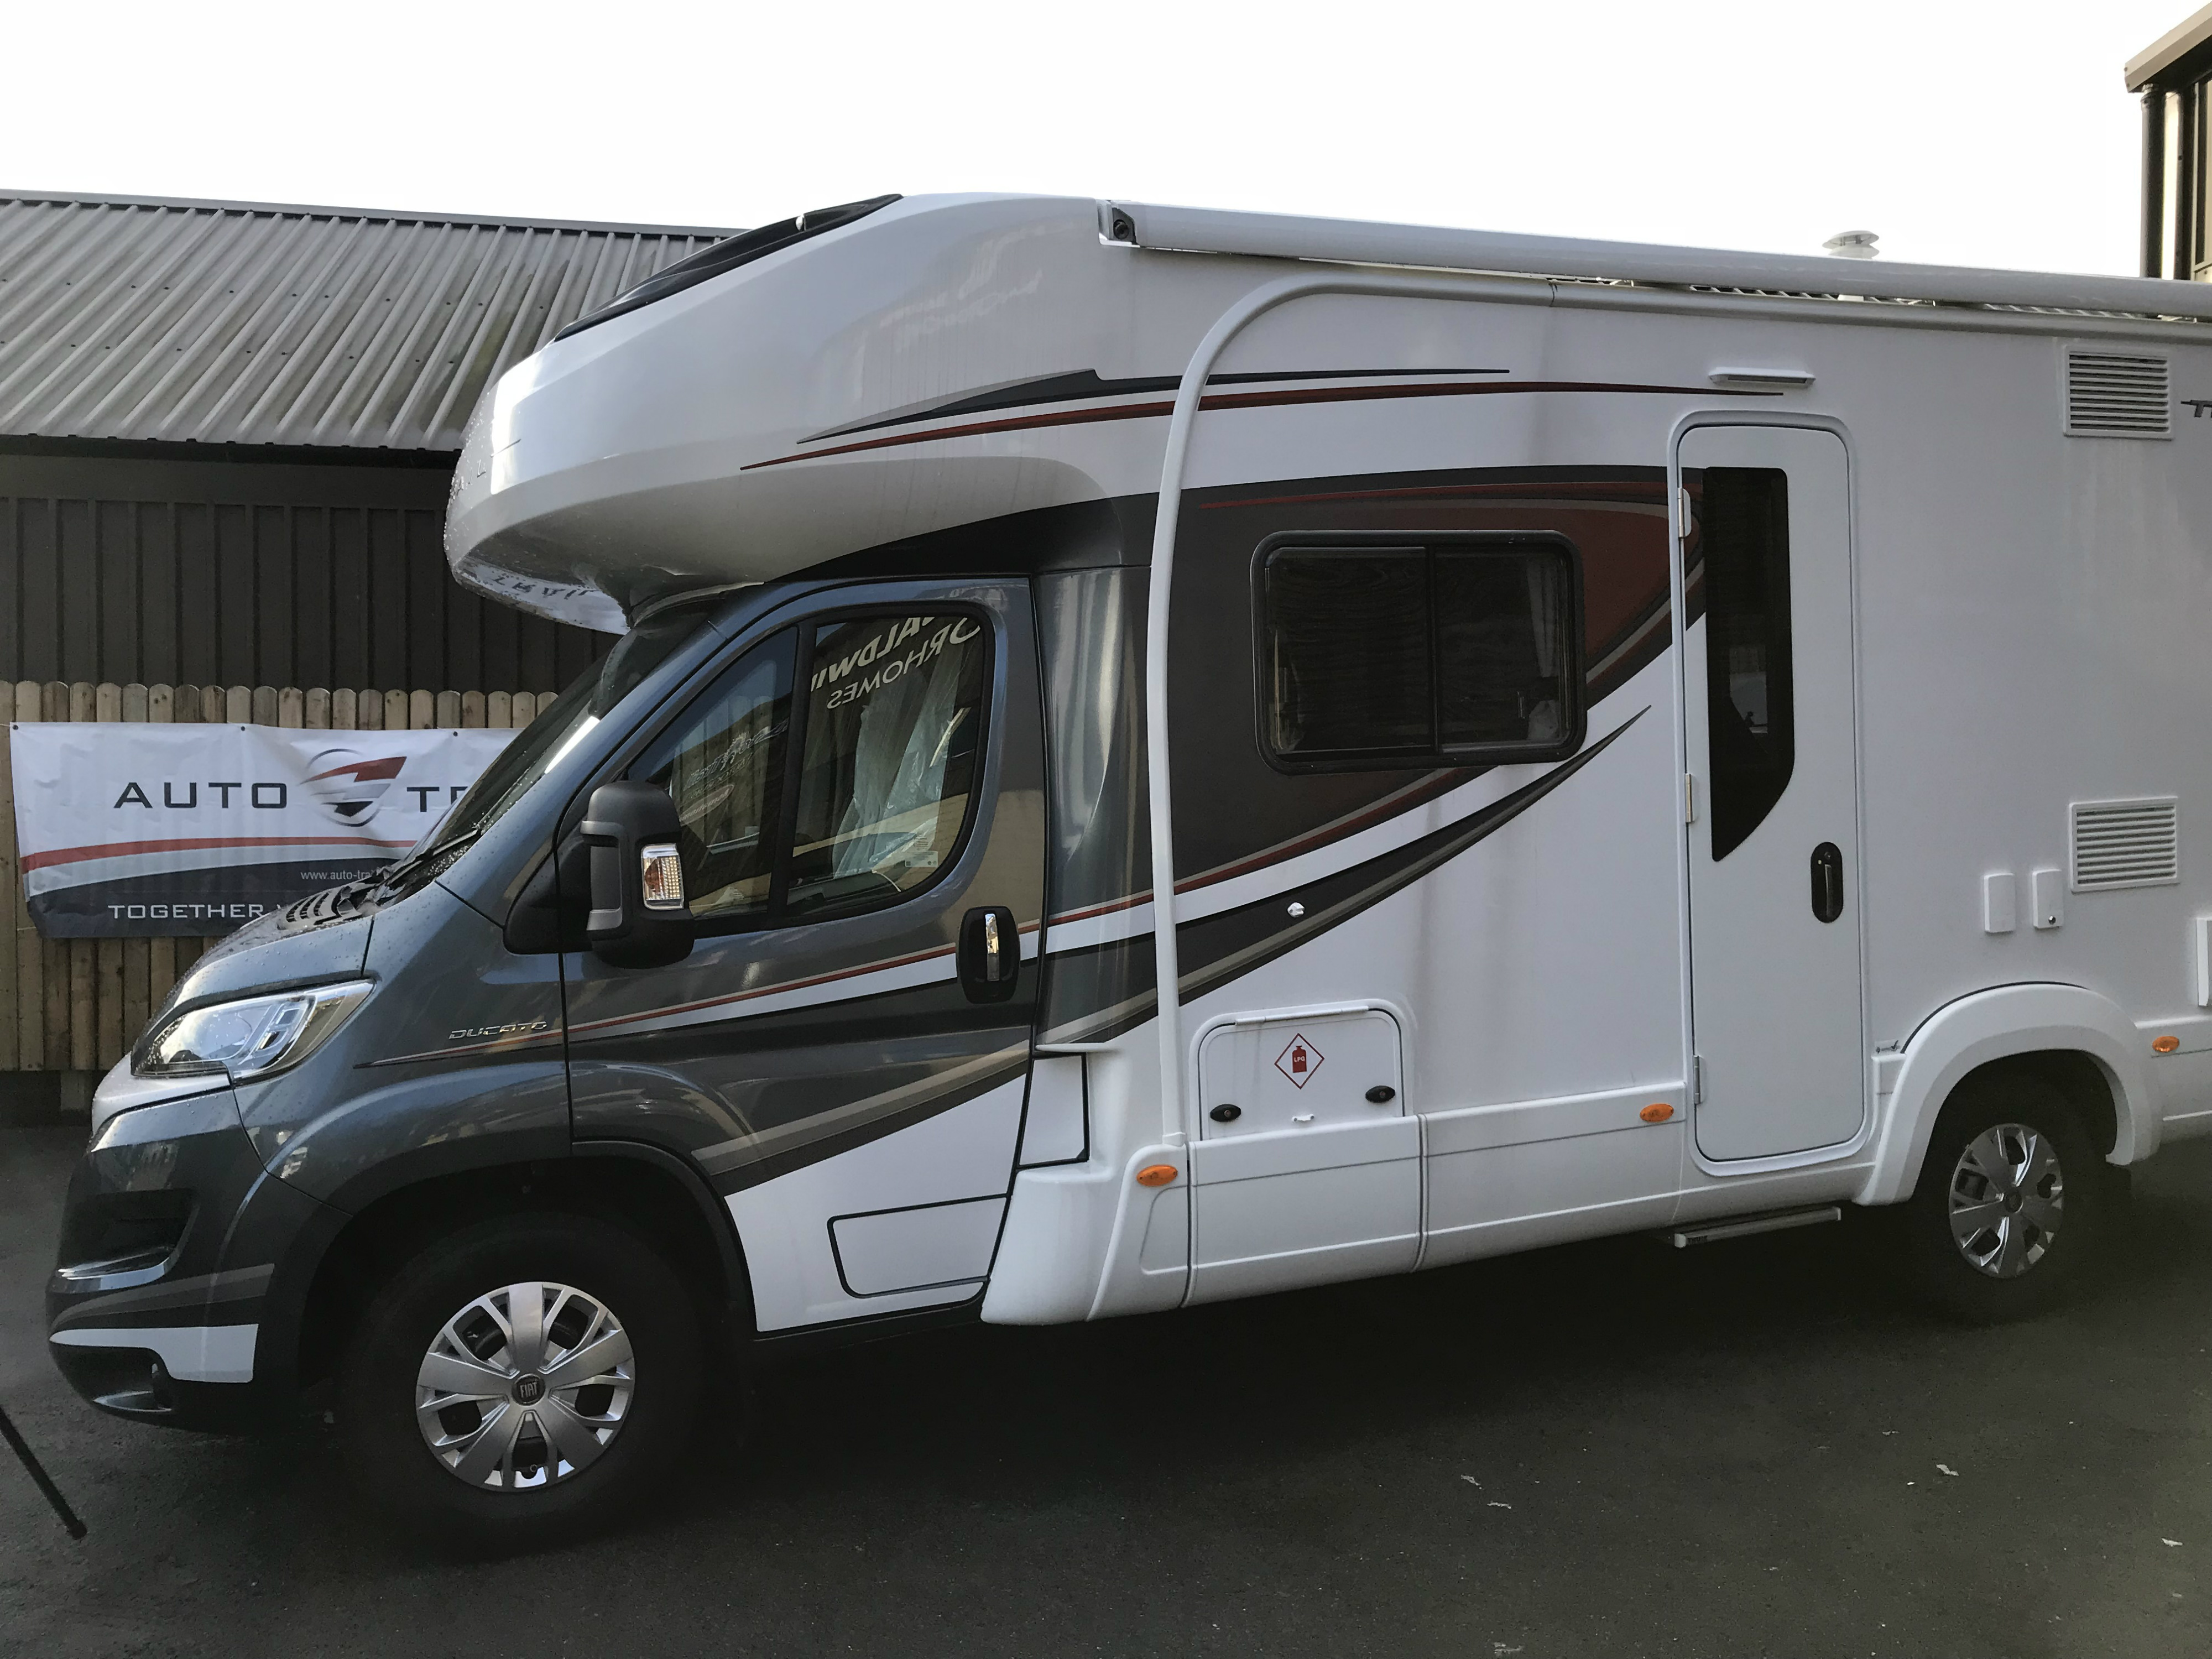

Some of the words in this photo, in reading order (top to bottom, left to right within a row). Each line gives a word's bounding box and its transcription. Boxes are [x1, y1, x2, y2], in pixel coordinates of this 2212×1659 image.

[113, 782, 287, 808] AUTO
[108, 904, 264, 919] TOGETHER
[448, 1021, 547, 1040] DUCATO
[519, 1382, 538, 1399] FIAT
